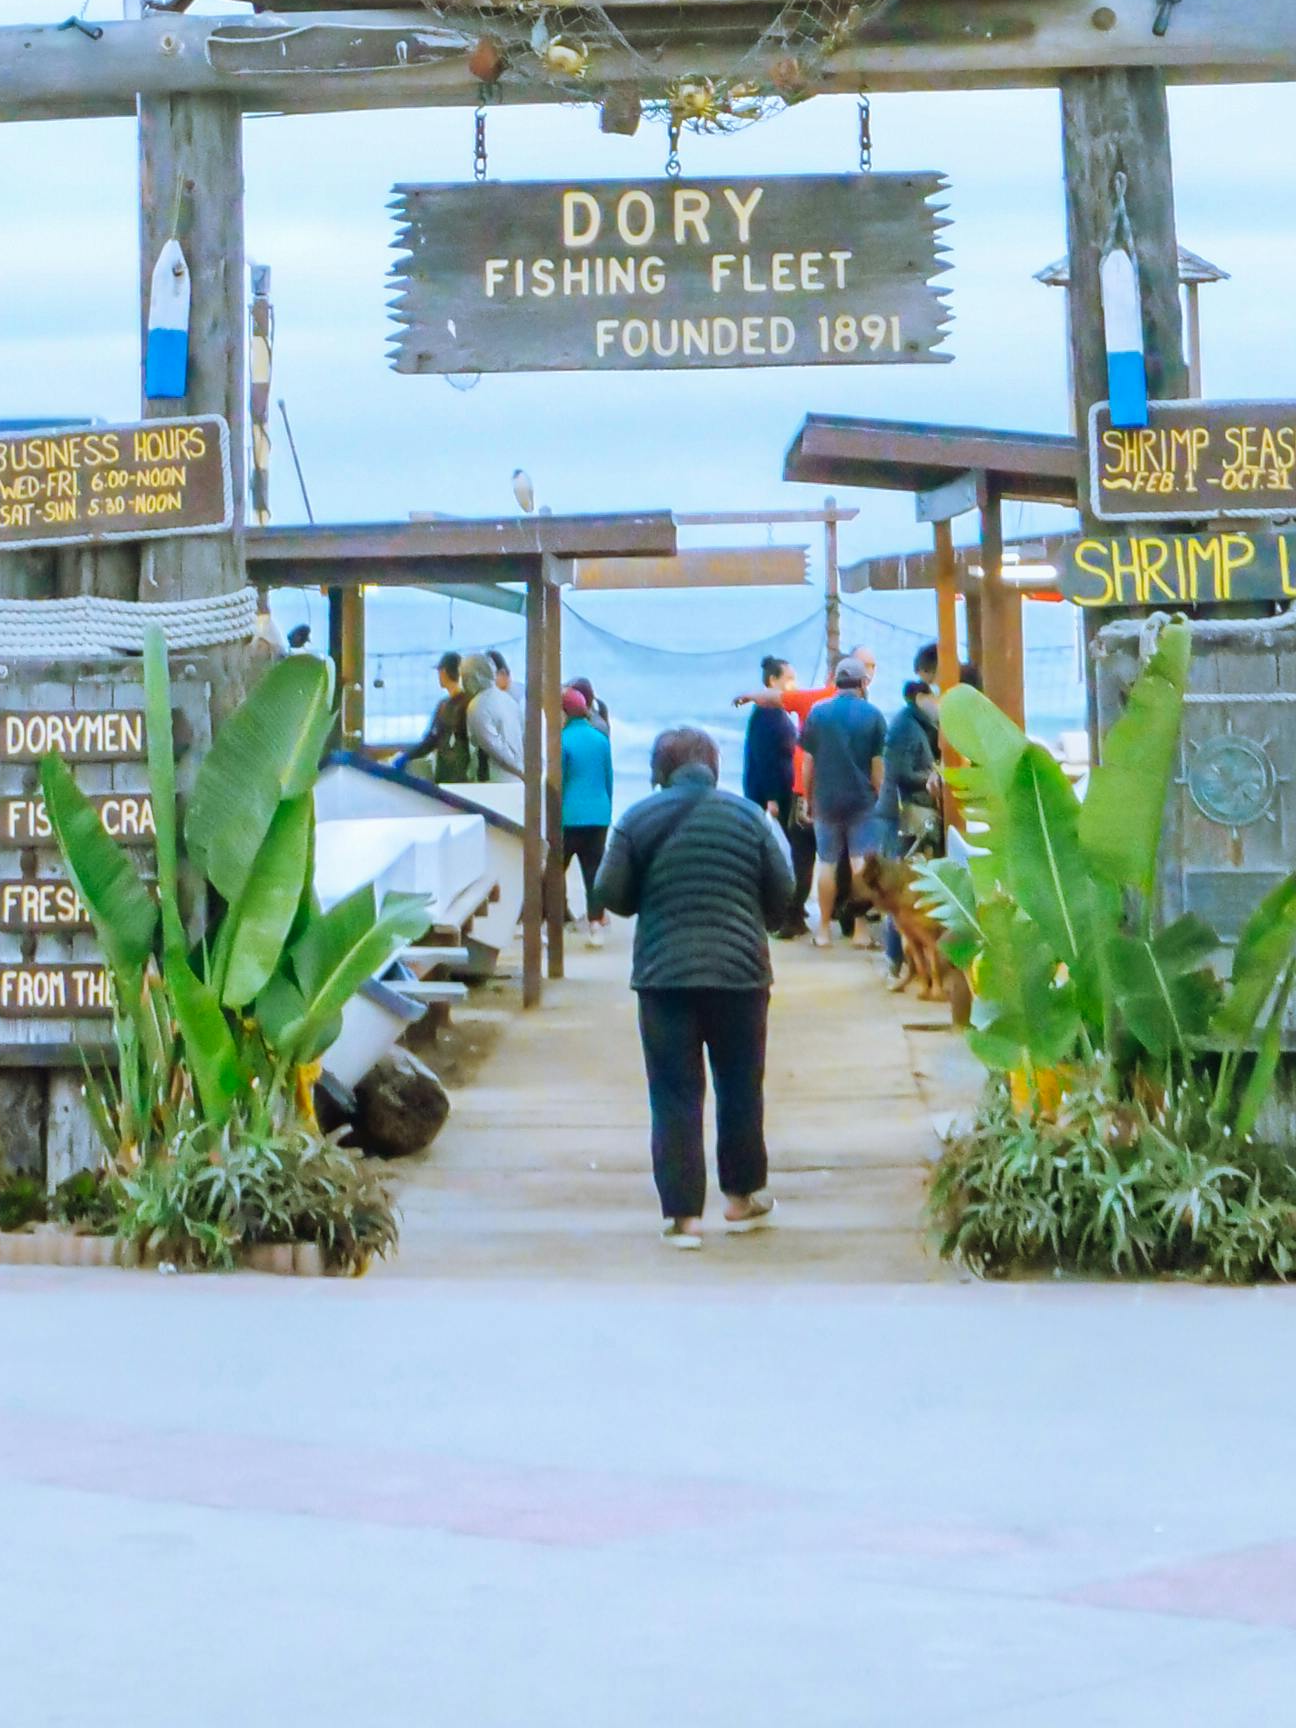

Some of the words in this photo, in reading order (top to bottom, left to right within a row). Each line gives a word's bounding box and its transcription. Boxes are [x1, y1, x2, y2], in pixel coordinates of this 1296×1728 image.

[563, 187, 764, 247] DORY
[485, 256, 666, 298] FISHING
[712, 251, 853, 293] FLEET
[597, 317, 795, 357] FOUNDED
[818, 314, 901, 353] 1891
[134, 427, 206, 461] HOURS
[1103, 427, 1209, 473] SHRIMP
[1074, 533, 1255, 607] SHRIMP
[6, 714, 142, 754] DORYMEN
[9, 801, 53, 838] FIS
[102, 798, 158, 835] CRA
[1, 970, 66, 1007] FROM
